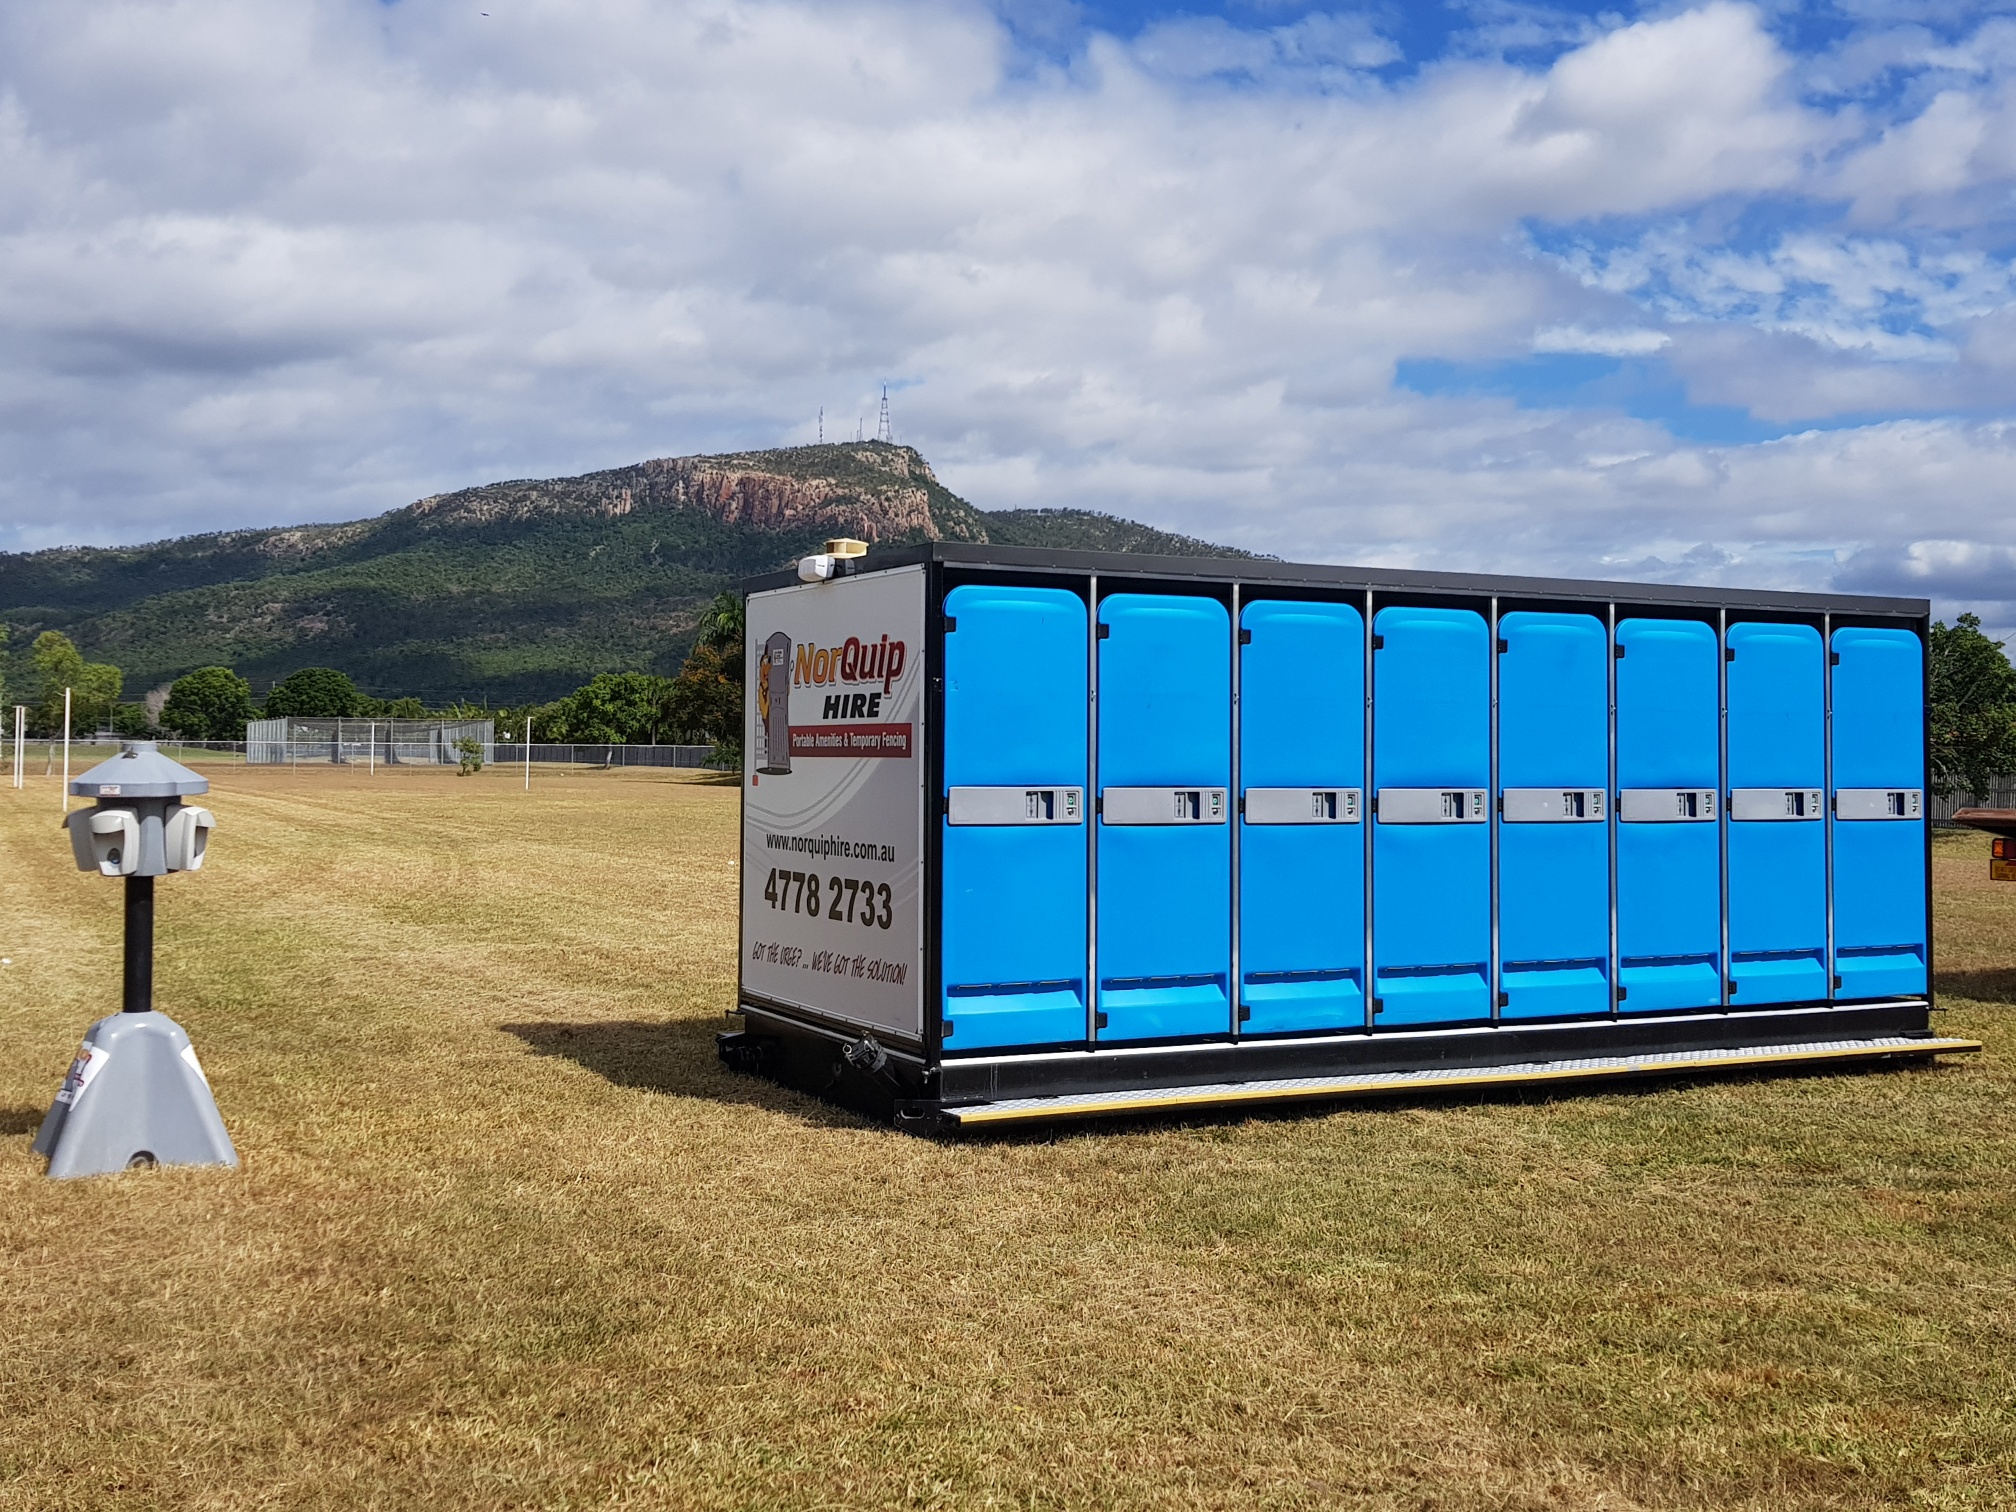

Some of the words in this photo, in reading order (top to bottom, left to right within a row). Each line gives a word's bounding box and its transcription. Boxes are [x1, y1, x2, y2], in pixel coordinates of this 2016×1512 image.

[793, 633, 906, 696] NorQuip
[822, 692, 882, 720] HIRE
[792, 733, 815, 747] Portable
[815, 732, 842, 747] Amenities
[843, 732, 849, 747] &
[849, 732, 881, 750] Temporary
[882, 731, 907, 750] Fencing
[766, 833, 895, 862] www.norquiphire.com.au
[764, 867, 820, 917] 4778
[828, 876, 892, 930] 2733
[752, 941, 767, 960] GOT
[766, 942, 780, 964] THE
[811, 950, 834, 973] WE'VE
[833, 953, 850, 976] GOT
[851, 954, 867, 978] THE
[867, 958, 908, 985] SOLUTION!
